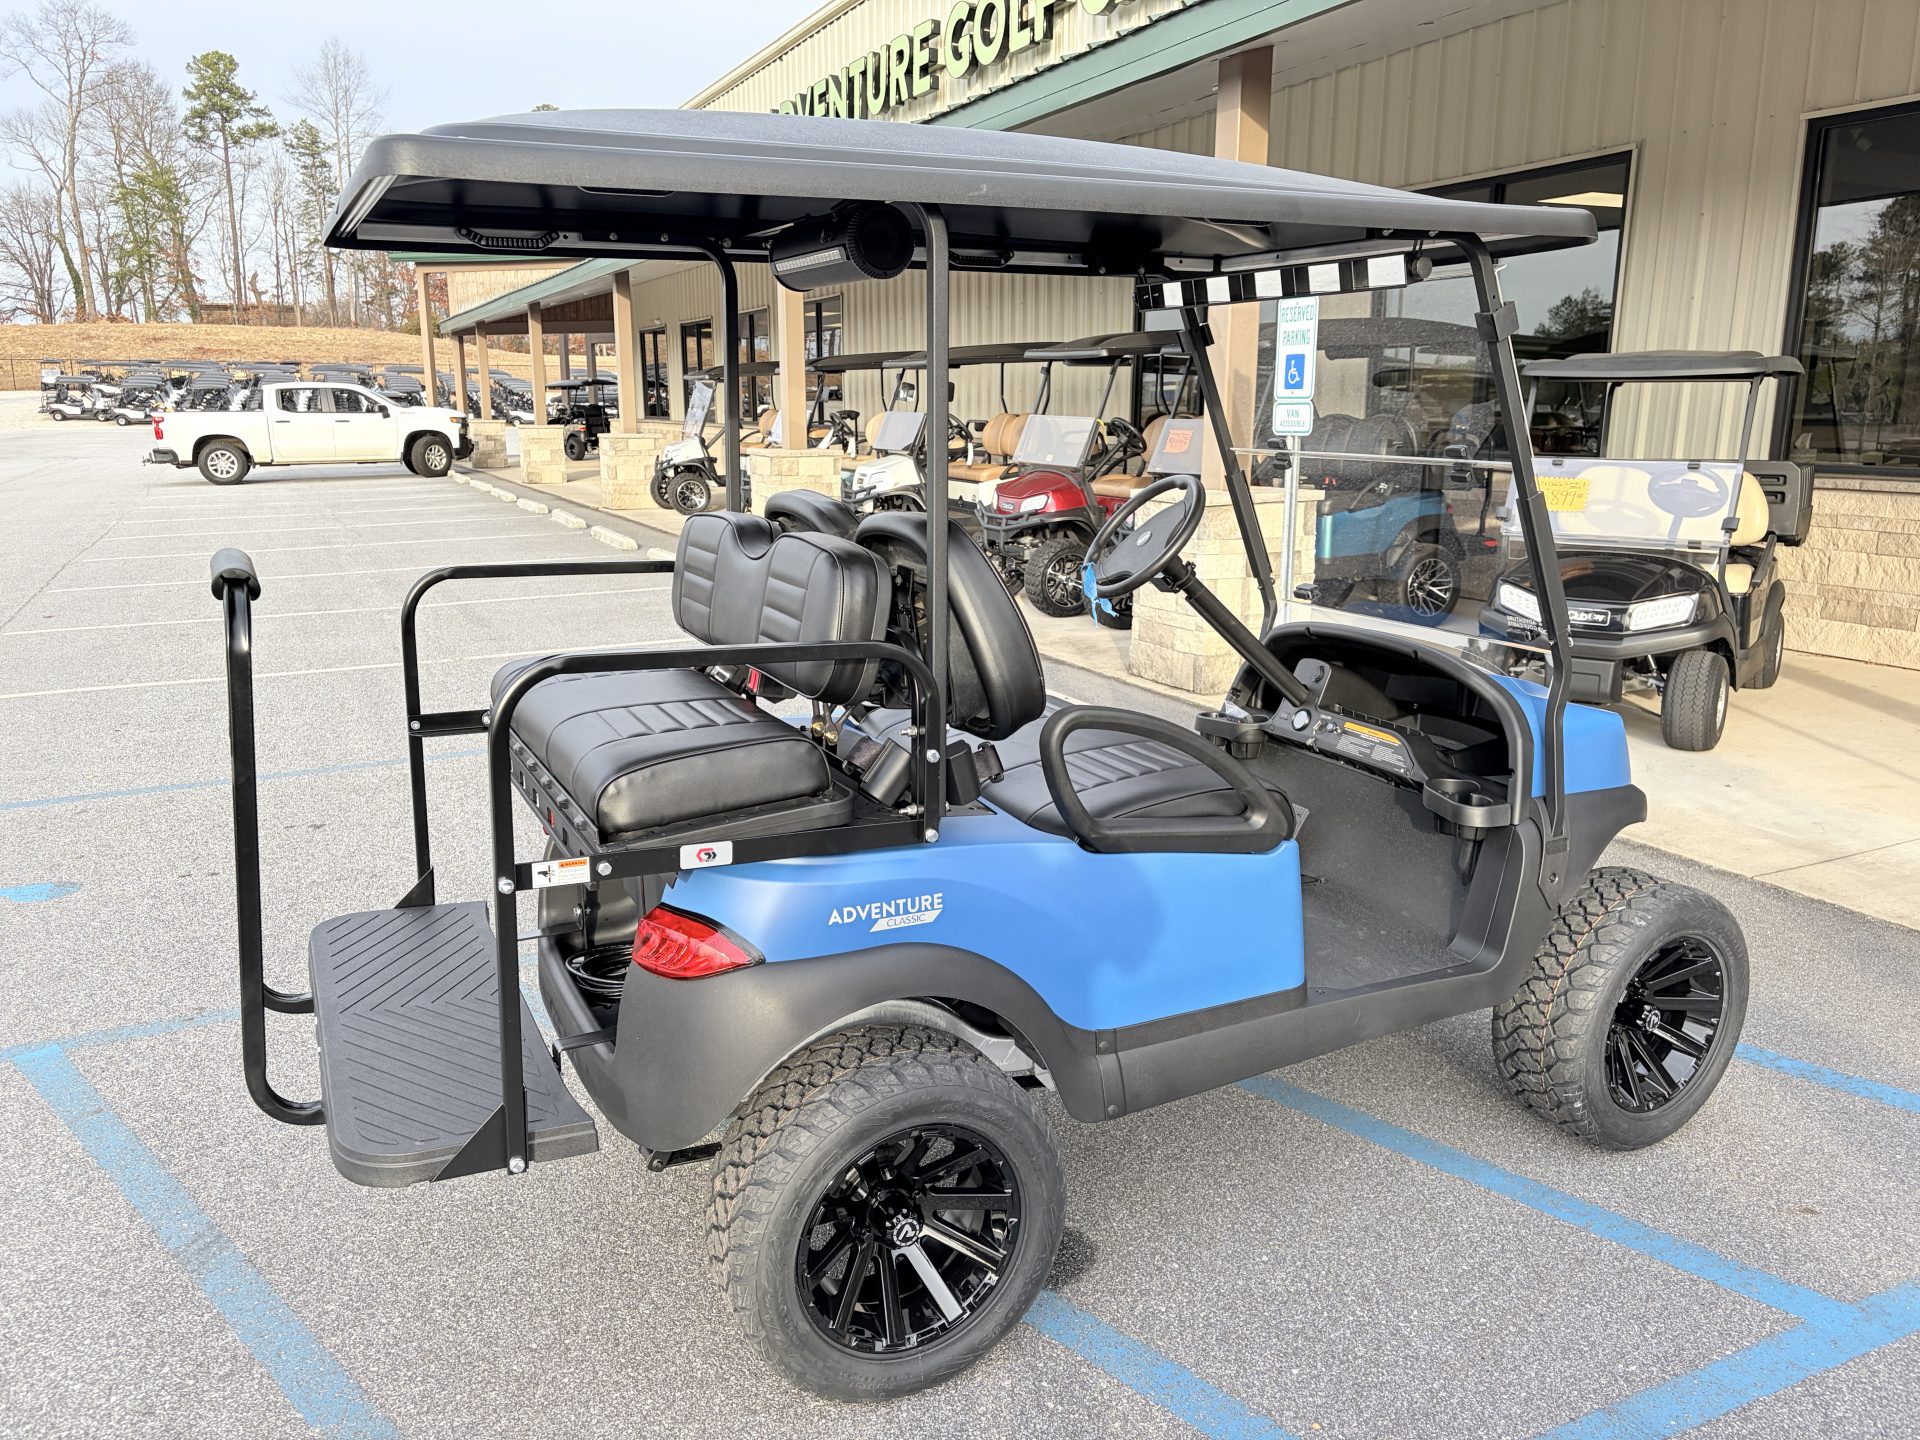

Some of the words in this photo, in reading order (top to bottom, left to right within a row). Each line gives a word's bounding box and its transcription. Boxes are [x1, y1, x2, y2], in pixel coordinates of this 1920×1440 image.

[1281, 305, 1314, 322] RESERVED
[1283, 329, 1310, 346] PARKING
[1286, 408, 1299, 418] VAN
[828, 893, 943, 925] ADVENTURE
[886, 914, 926, 927] CLASSIC
